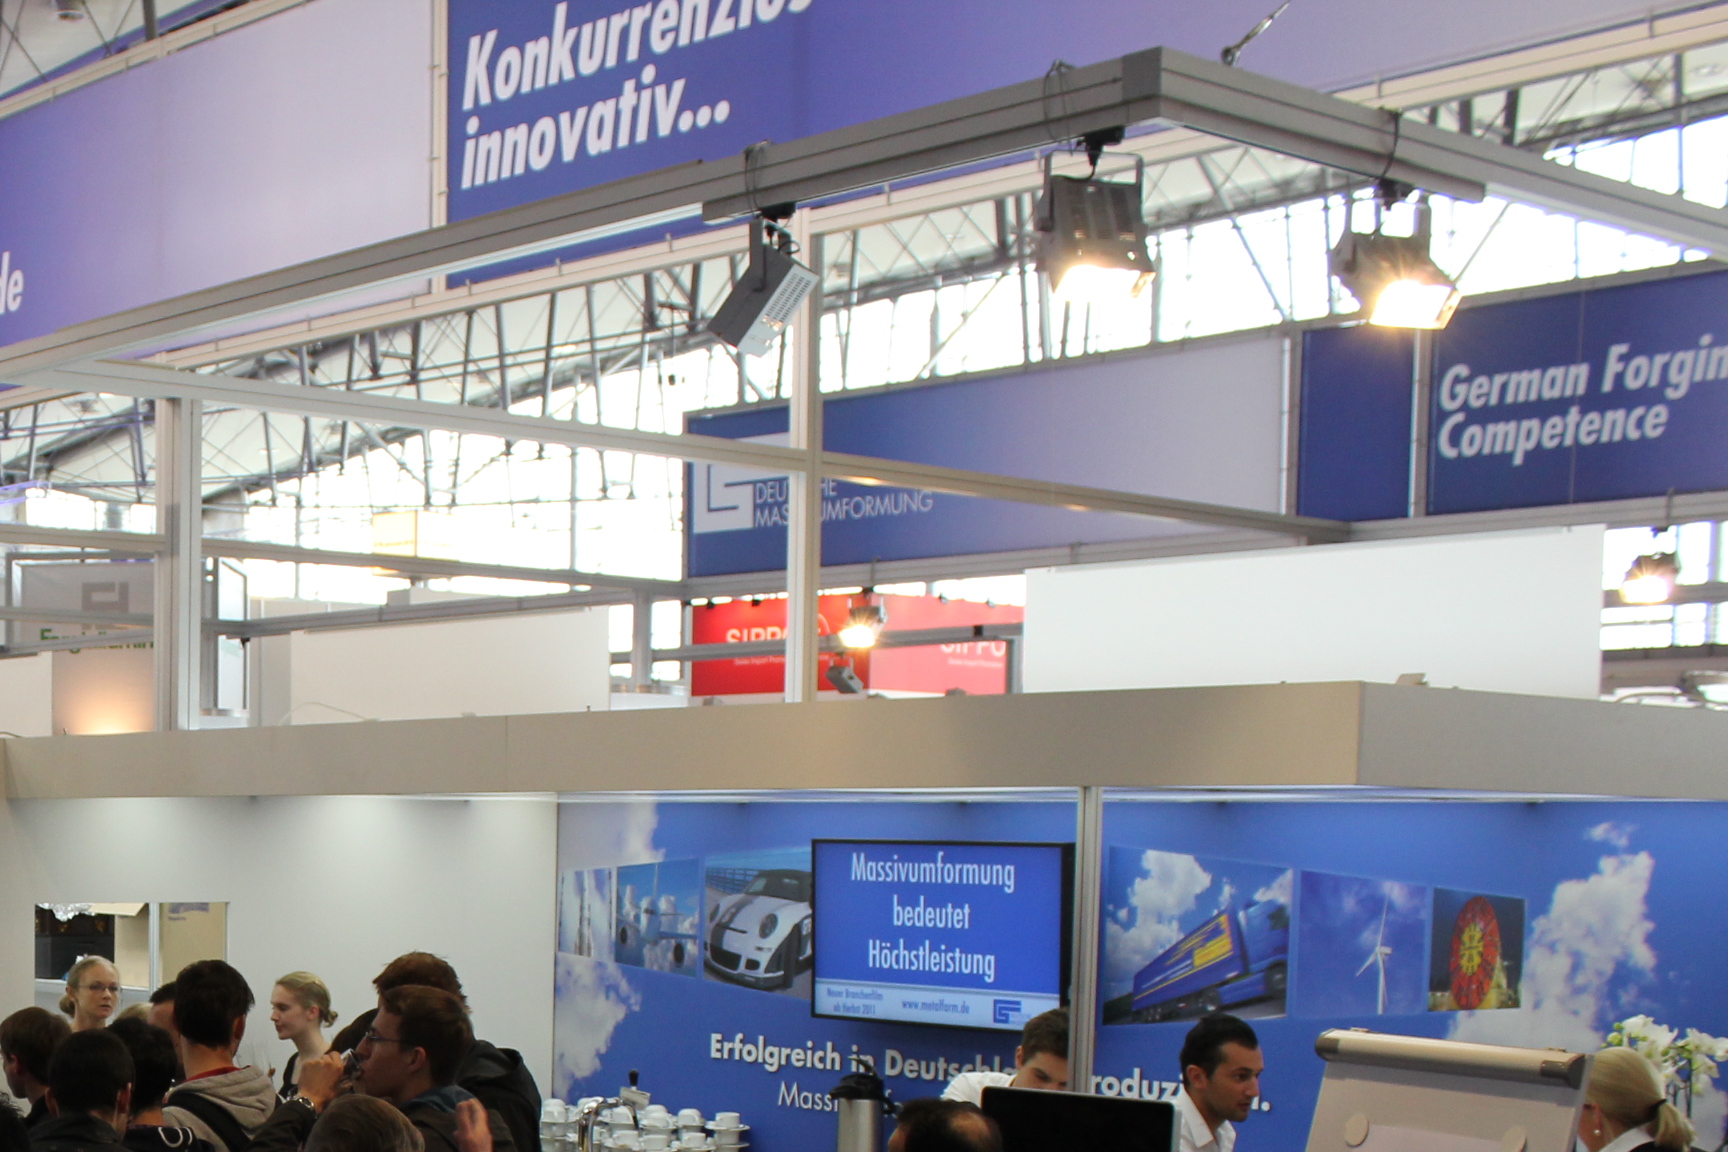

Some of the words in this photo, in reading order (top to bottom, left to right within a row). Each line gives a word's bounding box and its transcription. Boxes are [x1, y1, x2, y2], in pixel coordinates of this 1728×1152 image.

[460, 63, 731, 190] innovativ...
[1438, 362, 1590, 413] German
[1437, 403, 1669, 467] Competence
[851, 850, 1015, 894] Massivumformung
[893, 893, 971, 929] bedeutet
[868, 937, 995, 984] Höchstleistung
[710, 1032, 841, 1072] Erfolgreich
